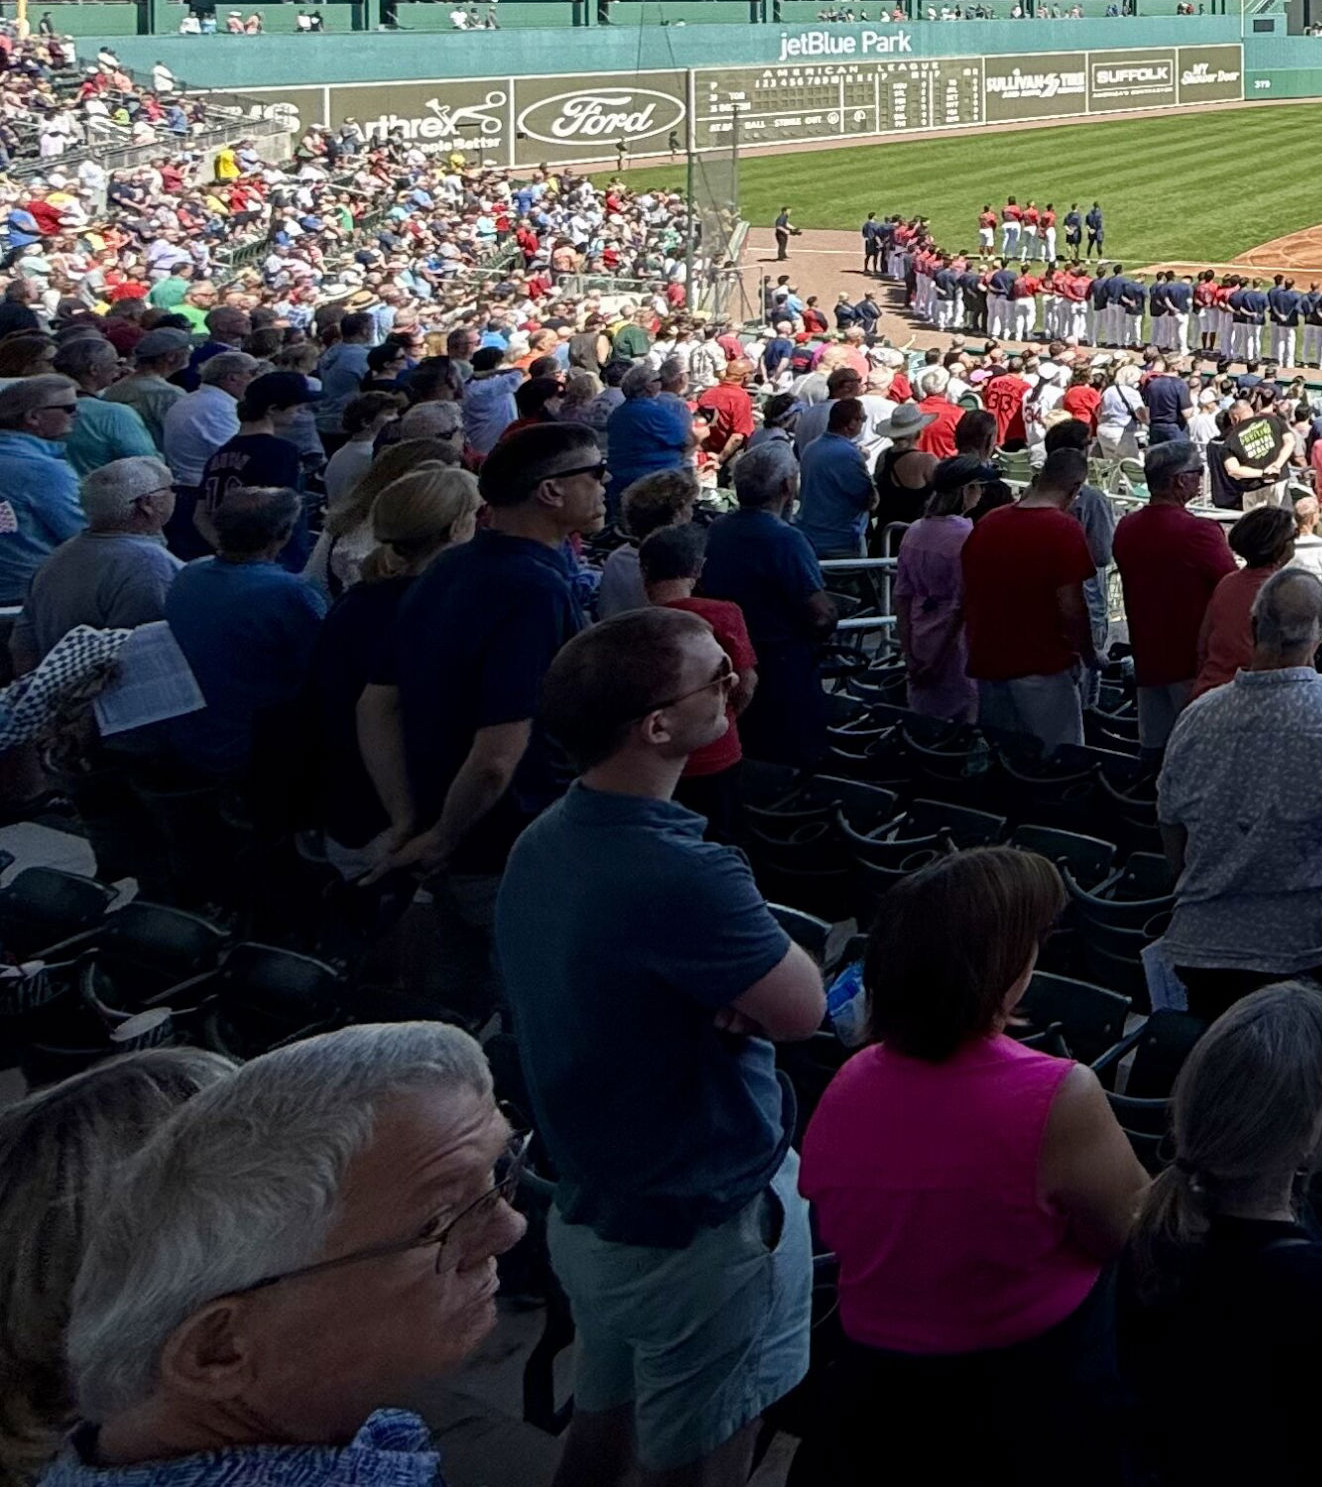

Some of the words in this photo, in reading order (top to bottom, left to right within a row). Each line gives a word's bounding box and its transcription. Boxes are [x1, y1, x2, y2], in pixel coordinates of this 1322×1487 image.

[779, 31, 856, 61] jetBlue
[862, 30, 912, 54] Park
[763, 65, 859, 78] AMERICAN
[877, 61, 939, 72] LEAGUE
[1096, 66, 1168, 84] SUFFOLK
[552, 96, 656, 137] Ford
